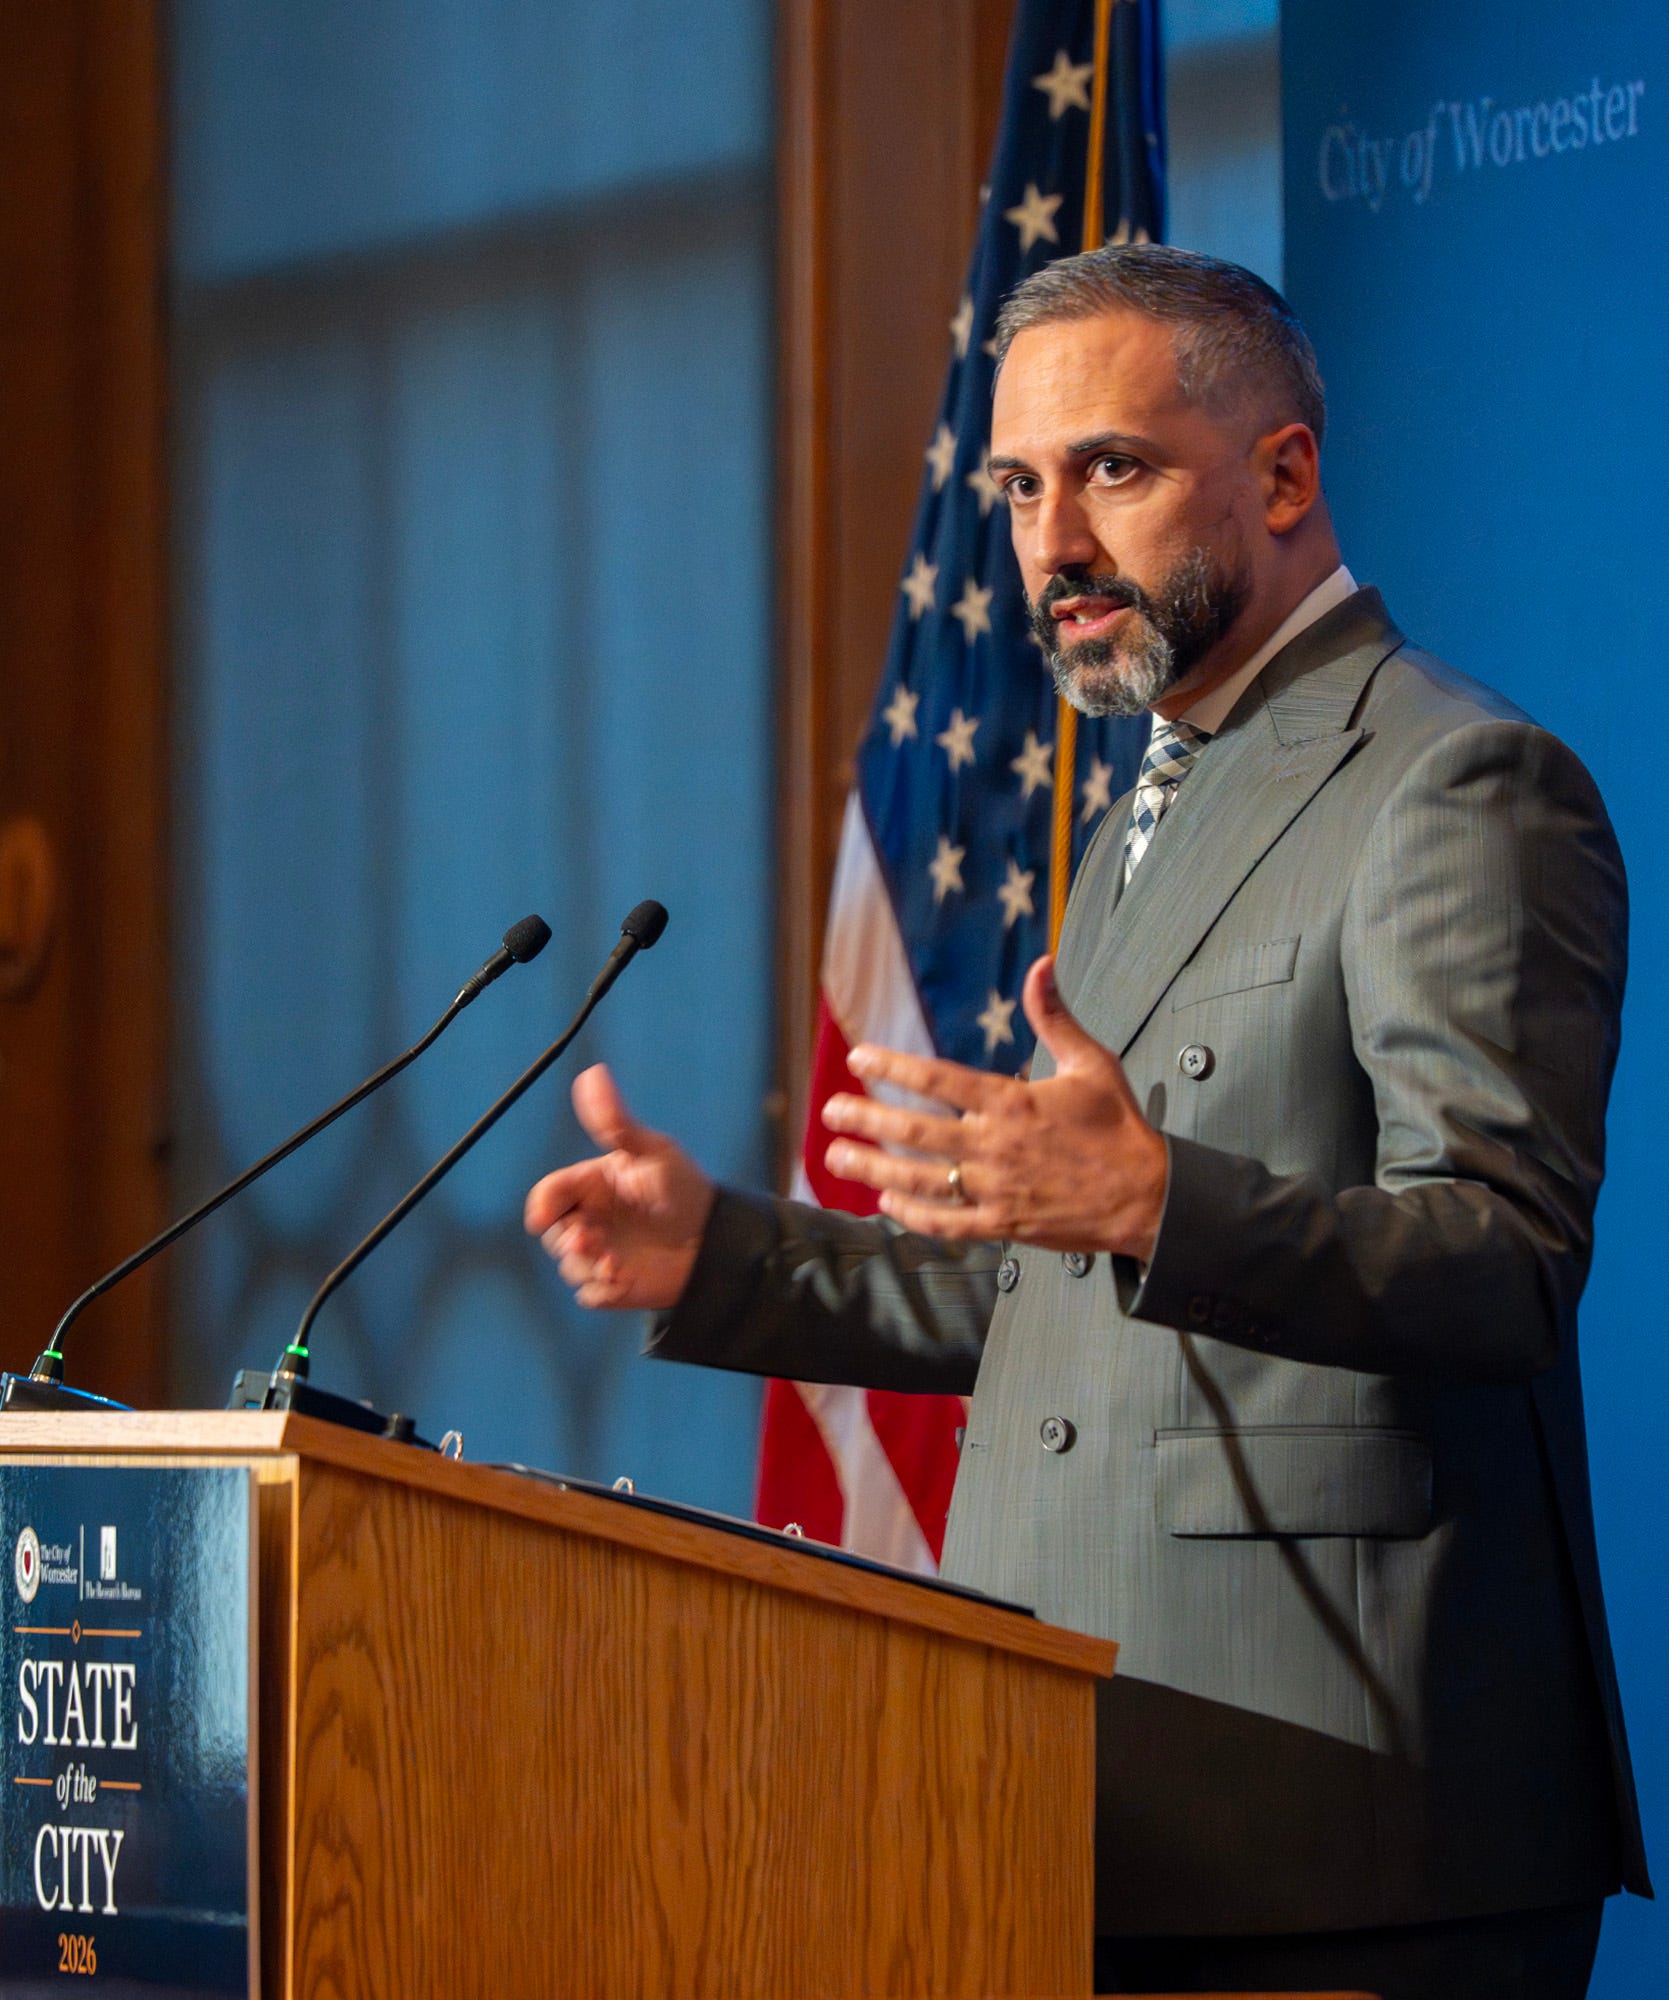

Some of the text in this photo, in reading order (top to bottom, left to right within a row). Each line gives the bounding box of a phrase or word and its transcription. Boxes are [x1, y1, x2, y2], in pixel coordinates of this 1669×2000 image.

[1319, 77, 1645, 213] City of Worcester
[40, 1563, 78, 1584] Worcester
[18, 1658, 137, 1750] STATE
[56, 1764, 97, 1810] of the
[33, 1823, 124, 1916] CITY
[58, 1933, 97, 1976] 2026
